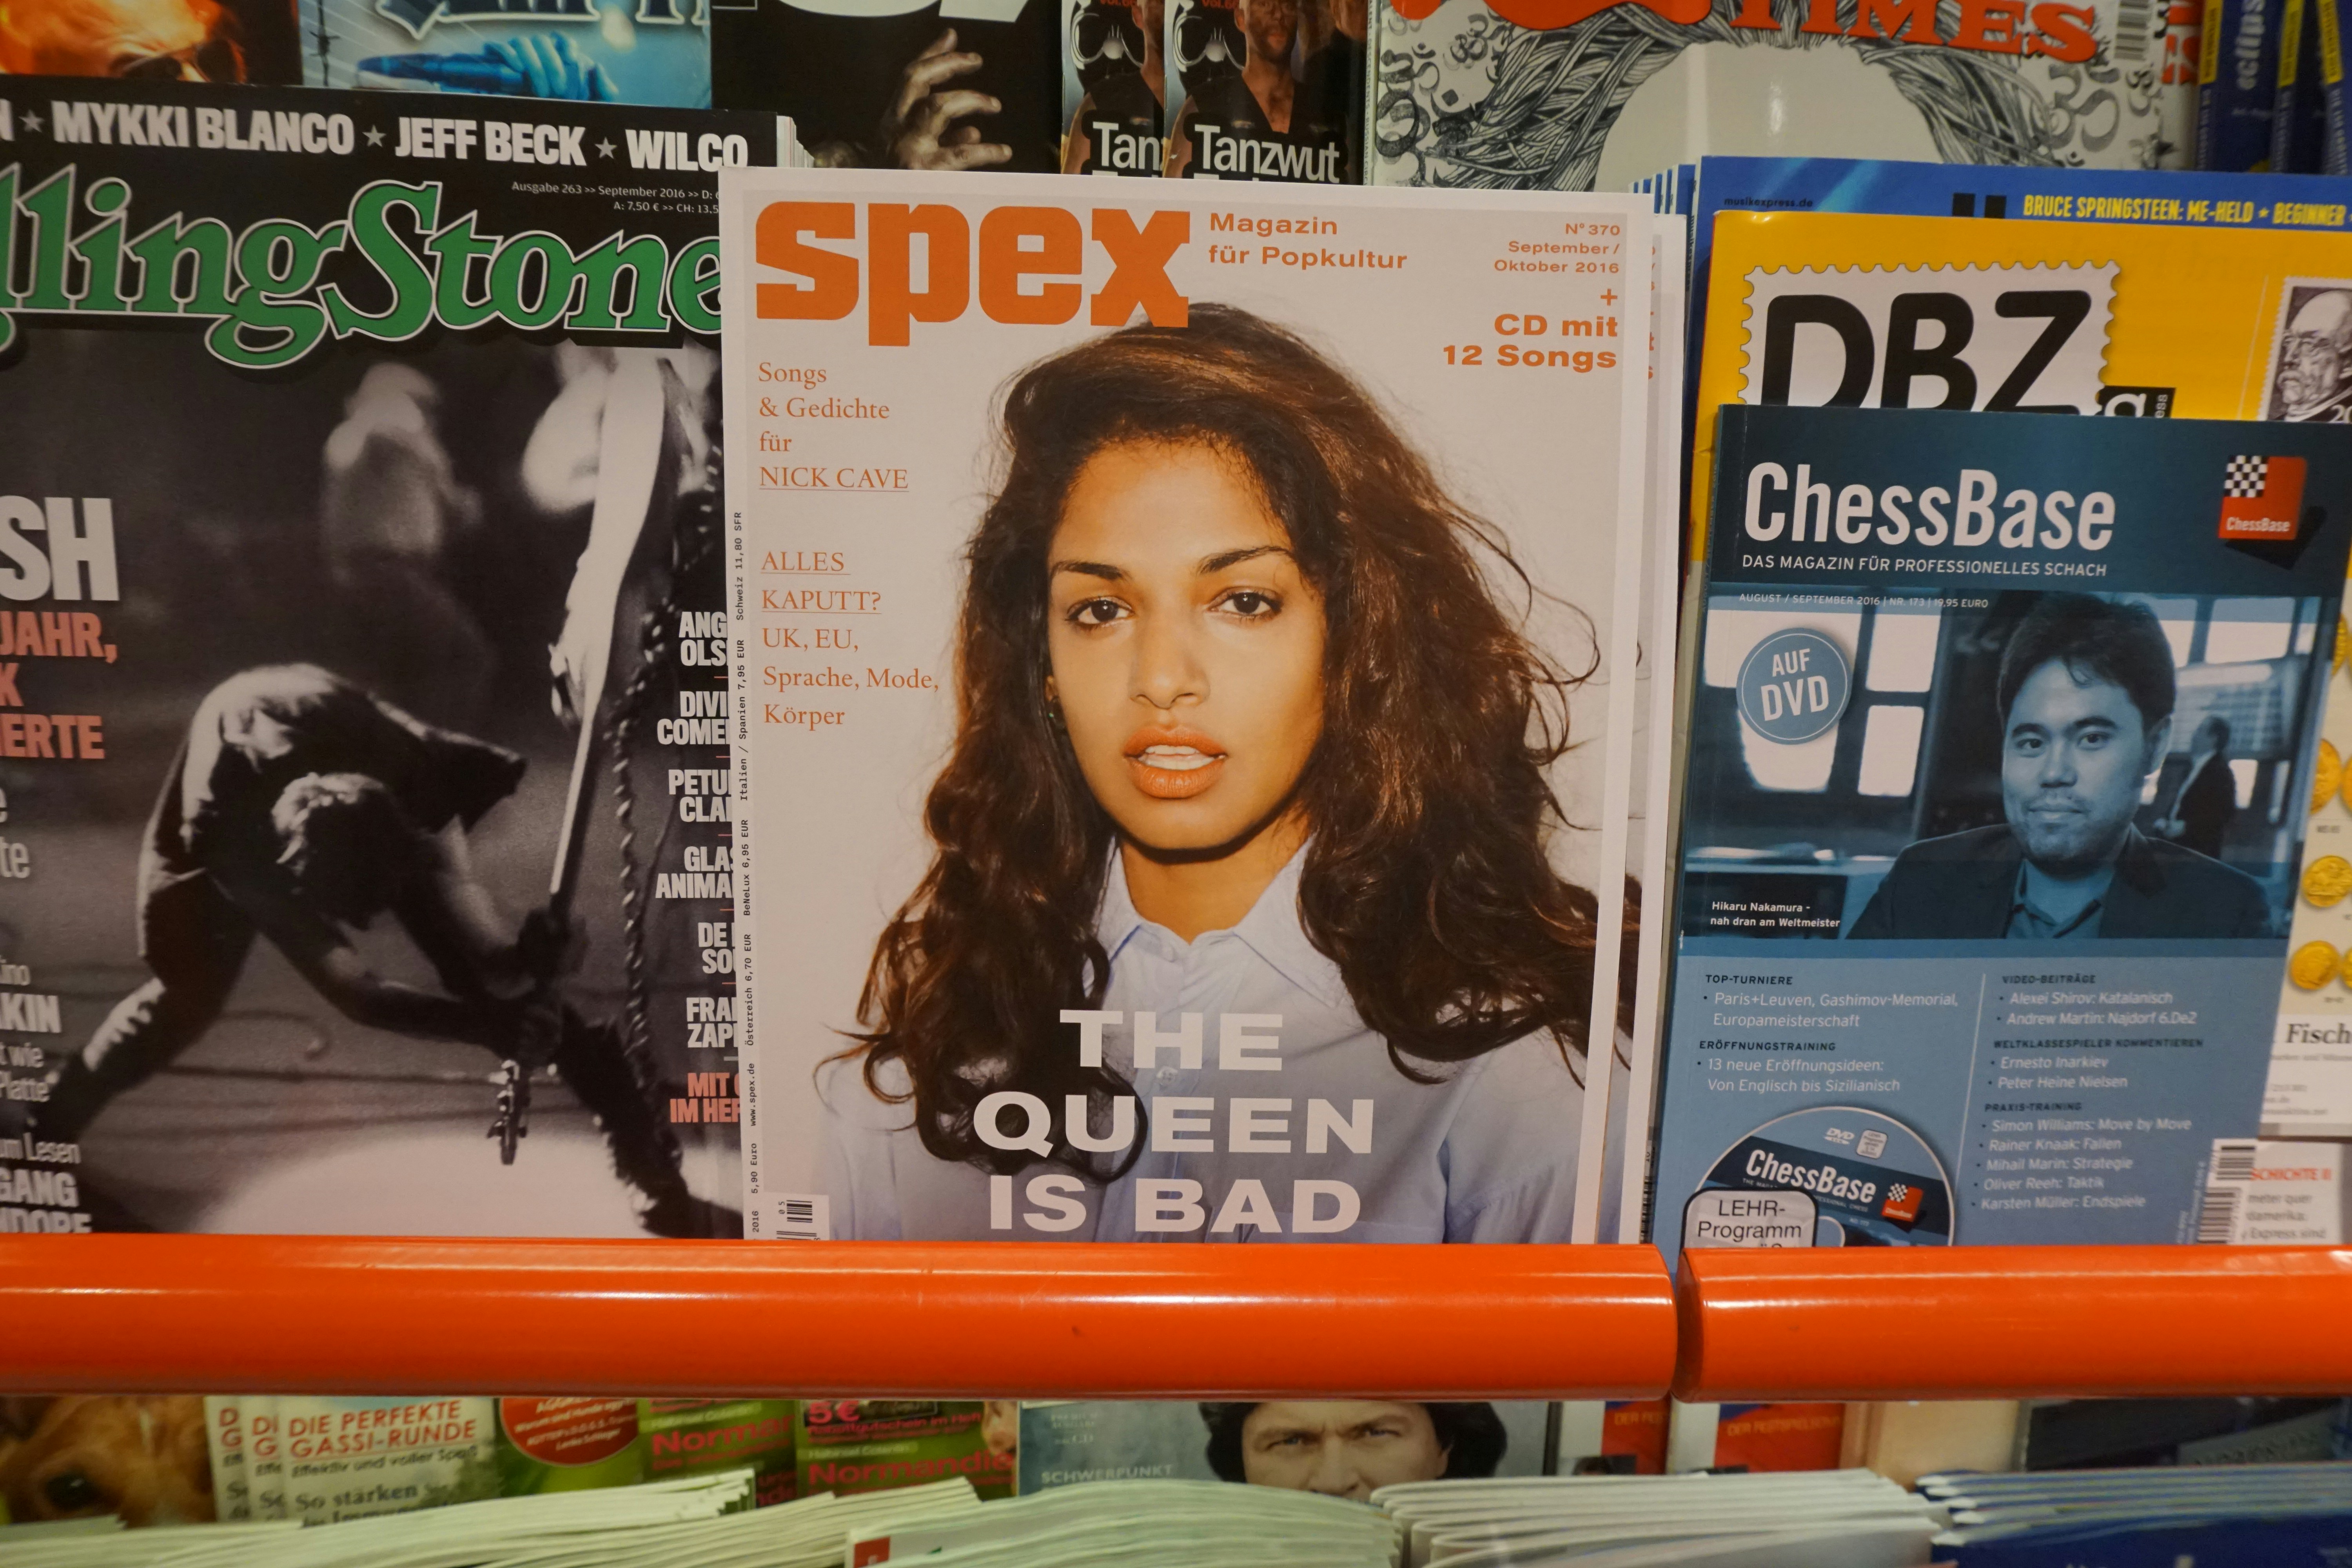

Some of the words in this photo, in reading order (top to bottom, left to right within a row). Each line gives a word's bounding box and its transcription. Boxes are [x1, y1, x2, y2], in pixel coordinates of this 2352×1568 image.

[51, 100, 190, 147] MYKKI
[195, 107, 355, 154] BLANCO
[395, 117, 477, 159] JEFF
[484, 121, 586, 166] BECK
[625, 129, 748, 172] WILCO
[1194, 124, 1341, 184] Tanzwut
[512, 181, 559, 194] Ausgabe
[562, 183, 582, 194] 263
[598, 186, 657, 199] September
[660, 188, 685, 198] 2016
[614, 201, 624, 211] A:
[677, 204, 695, 213] CH:
[2024, 195, 2073, 218] BRUCE
[2076, 197, 2183, 221] SPRINGSTEEN:
[2187, 201, 2254, 223] ME-HELD
[1210, 213, 1338, 237] Magazin
[1588, 224, 1620, 236] 370
[1209, 245, 1250, 264] für
[1262, 246, 1408, 270] Popkultur
[1508, 240, 1609, 255] September
[756, 201, 1190, 347] spex
[1494, 260, 1567, 273] Oktober
[1575, 261, 1619, 274] 2016
[1494, 314, 1547, 336] CD
[1562, 315, 1618, 337] mit
[1443, 345, 1483, 365] 12
[1497, 344, 1617, 373] Songs
[1760, 290, 2092, 412] DBZ
[759, 362, 827, 390] Songs
[759, 397, 779, 417] &
[786, 397, 890, 419] Gedichte
[759, 430, 792, 452] für
[760, 466, 828, 488] NICK
[837, 468, 909, 489] CAVE
[1745, 461, 2115, 550] ChessBase
[734, 512, 742, 531] SFR
[2227, 516, 2290, 533] ChessBase
[735, 537, 744, 570] 11,80
[762, 551, 844, 572] ALLES
[1742, 555, 1774, 568] DAS
[1780, 556, 1854, 570] MAGAZIN
[1859, 556, 1889, 572] FÜR
[1895, 559, 2040, 575] PROFESSIONELLES
[2044, 562, 2107, 577] SCHACH
[735, 577, 744, 621] Schweiz
[762, 590, 881, 611] KAPUTT?
[1739, 593, 1781, 603] AUGUST
[1793, 595, 1854, 605] SEPTEMBER
[1857, 596, 1880, 606] 2016
[1889, 597, 1906, 606] NR.
[1909, 598, 1924, 606] 173
[1962, 599, 1989, 608] EURO
[762, 628, 808, 652] UK,
[815, 629, 859, 652] EU,
[1772, 648, 1810, 677] AUF
[737, 664, 747, 690] 7,95
[763, 666, 859, 693] Sprache,
[866, 668, 939, 692] Mode,
[1760, 675, 1829, 721] DVD
[739, 696, 748, 740] Spanien
[764, 704, 845, 731] Körper
[739, 758, 748, 801] Italien
[742, 844, 751, 868] 6,95
[655, 873, 734, 898] ANIMA
[1711, 902, 1747, 911] Hikaru
[1750, 902, 1802, 913] Nakamura
[1710, 916, 1730, 926] nah
[1733, 916, 1756, 926] dran
[1779, 917, 1840, 928] Weltmeister
[698, 922, 727, 947] DE
[745, 958, 753, 982] 6,70
[1706, 975, 1793, 985] TOP-TURNIERE
[1715, 992, 1815, 1008] Paris+Leuven,
[1820, 993, 1958, 1007] Gashimov-Memorial,
[2009, 992, 2049, 1005] Alexei
[745, 987, 754, 1046] Österreich
[1713, 1013, 1860, 1029] Europameisterschaft
[2006, 1012, 2057, 1025] Andrew
[1060, 1009, 1283, 1071] THE
[1700, 1039, 1836, 1051] ERÖFFNUNGSTRAINING
[1708, 1059, 1722, 1071] 13
[1727, 1062, 1761, 1071] neue
[1766, 1059, 1884, 1074] Eröffnungsideen:
[2000, 1056, 2053, 1069] Ernesto
[688, 1073, 730, 1097] MIT
[747, 1063, 756, 1126] www.spex.de
[1708, 1079, 1734, 1091] Von
[1739, 1079, 1797, 1094] Englisch
[1802, 1079, 1820, 1092] bis
[1826, 1079, 1900, 1093] Sizilianisch
[1998, 1077, 2034, 1089] Peter
[2038, 1076, 2075, 1088] Heine
[2079, 1076, 2128, 1088] Nielsen
[670, 1099, 699, 1123] IM
[1984, 1102, 2082, 1112] PRAXIS-TRAINING
[973, 1091, 1374, 1158] QUEEN
[1992, 1119, 2033, 1132] Simon
[2098, 1119, 2133, 1131] Move
[2136, 1118, 2152, 1132] by
[2157, 1118, 2192, 1131] Move
[1989, 1139, 2031, 1152] Rainer
[751, 1171, 759, 1194] 5,90
[1746, 1149, 1877, 1203] ChessBase
[990, 1174, 1087, 1232] IS
[1135, 1178, 1361, 1234] BAD
[1719, 1199, 1786, 1216] LEHR-
[1698, 1221, 1802, 1242] Programm
[289, 1415, 330, 1438] DIE
[340, 1399, 461, 1432] PERFEKTE
[291, 1418, 477, 1458] GASSI-RUNDE
[808, 1450, 1014, 1486] Normandie
[1041, 1464, 1173, 1485] SCHWERPUNKT
